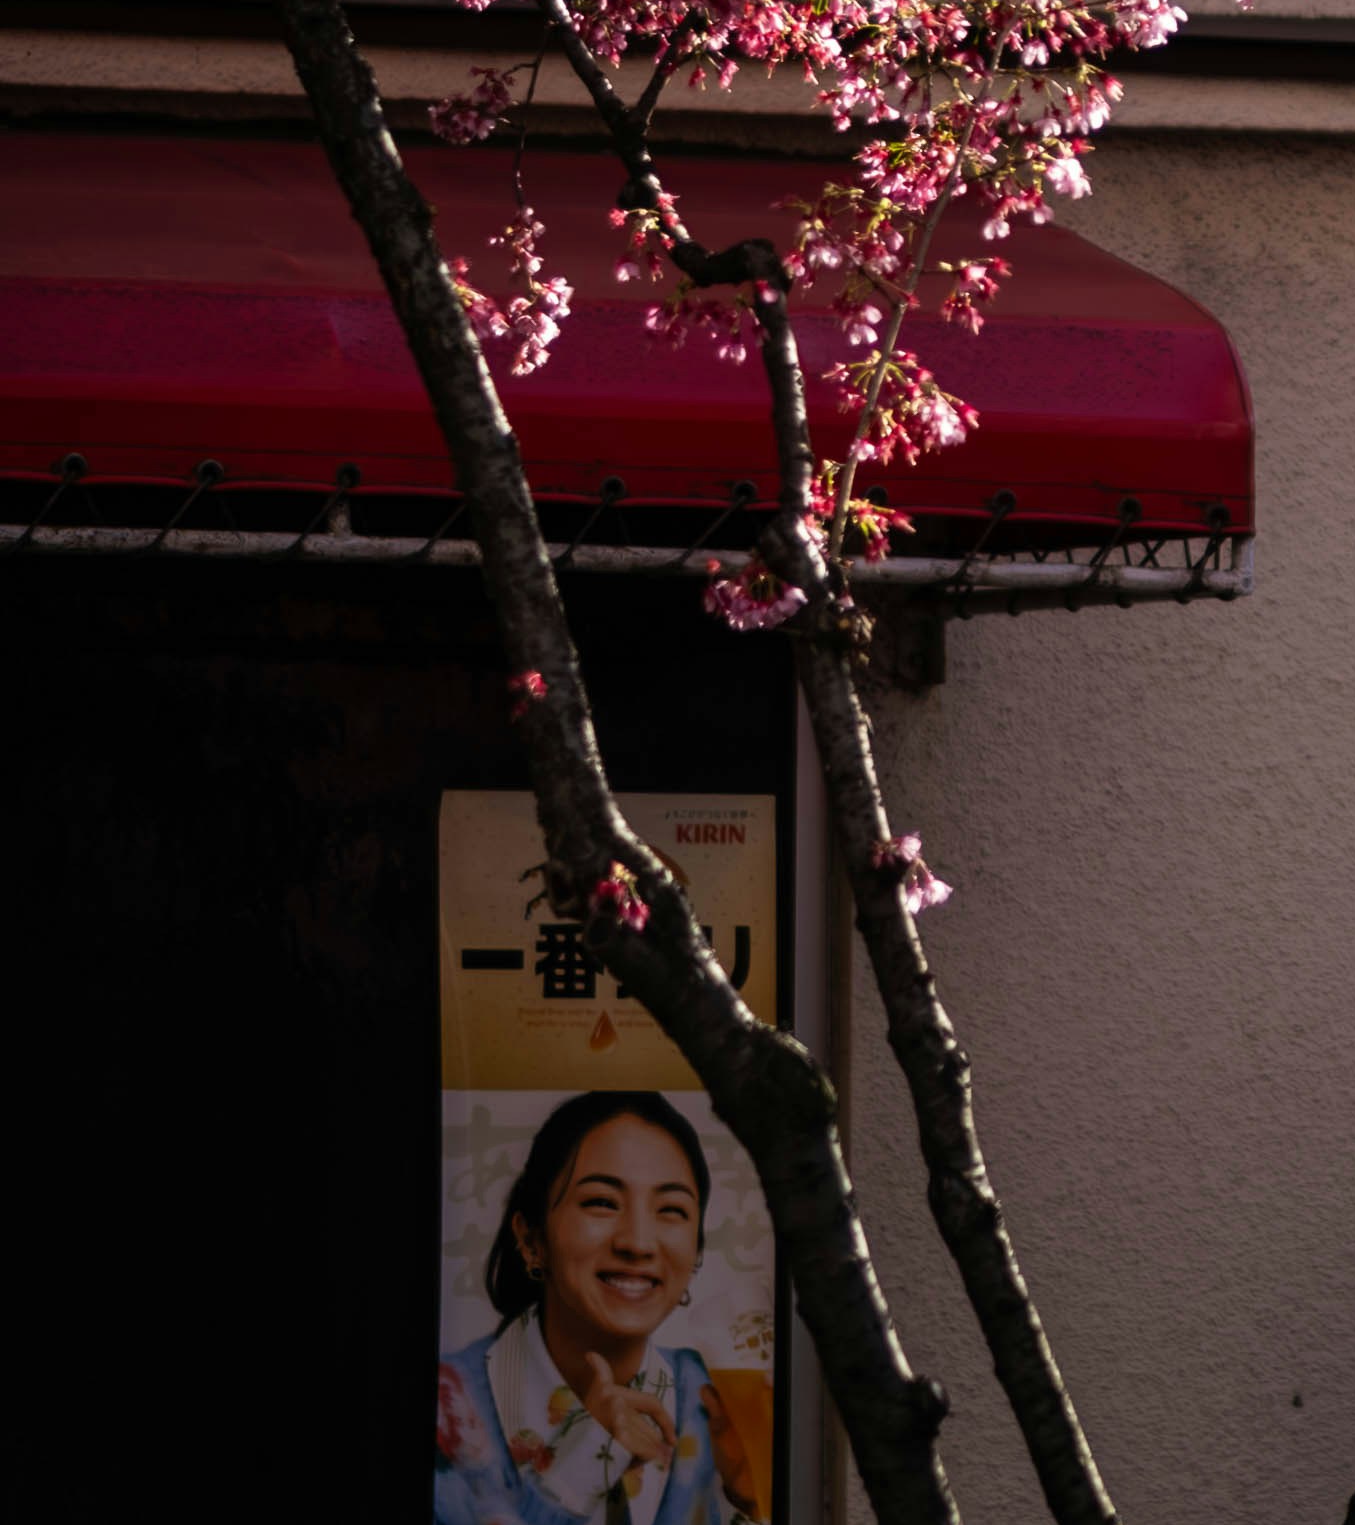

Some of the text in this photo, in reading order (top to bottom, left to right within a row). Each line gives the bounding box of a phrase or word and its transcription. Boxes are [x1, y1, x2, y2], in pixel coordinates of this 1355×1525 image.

[676, 823, 746, 845] KIRIN
[461, 924, 751, 999] 一番り
